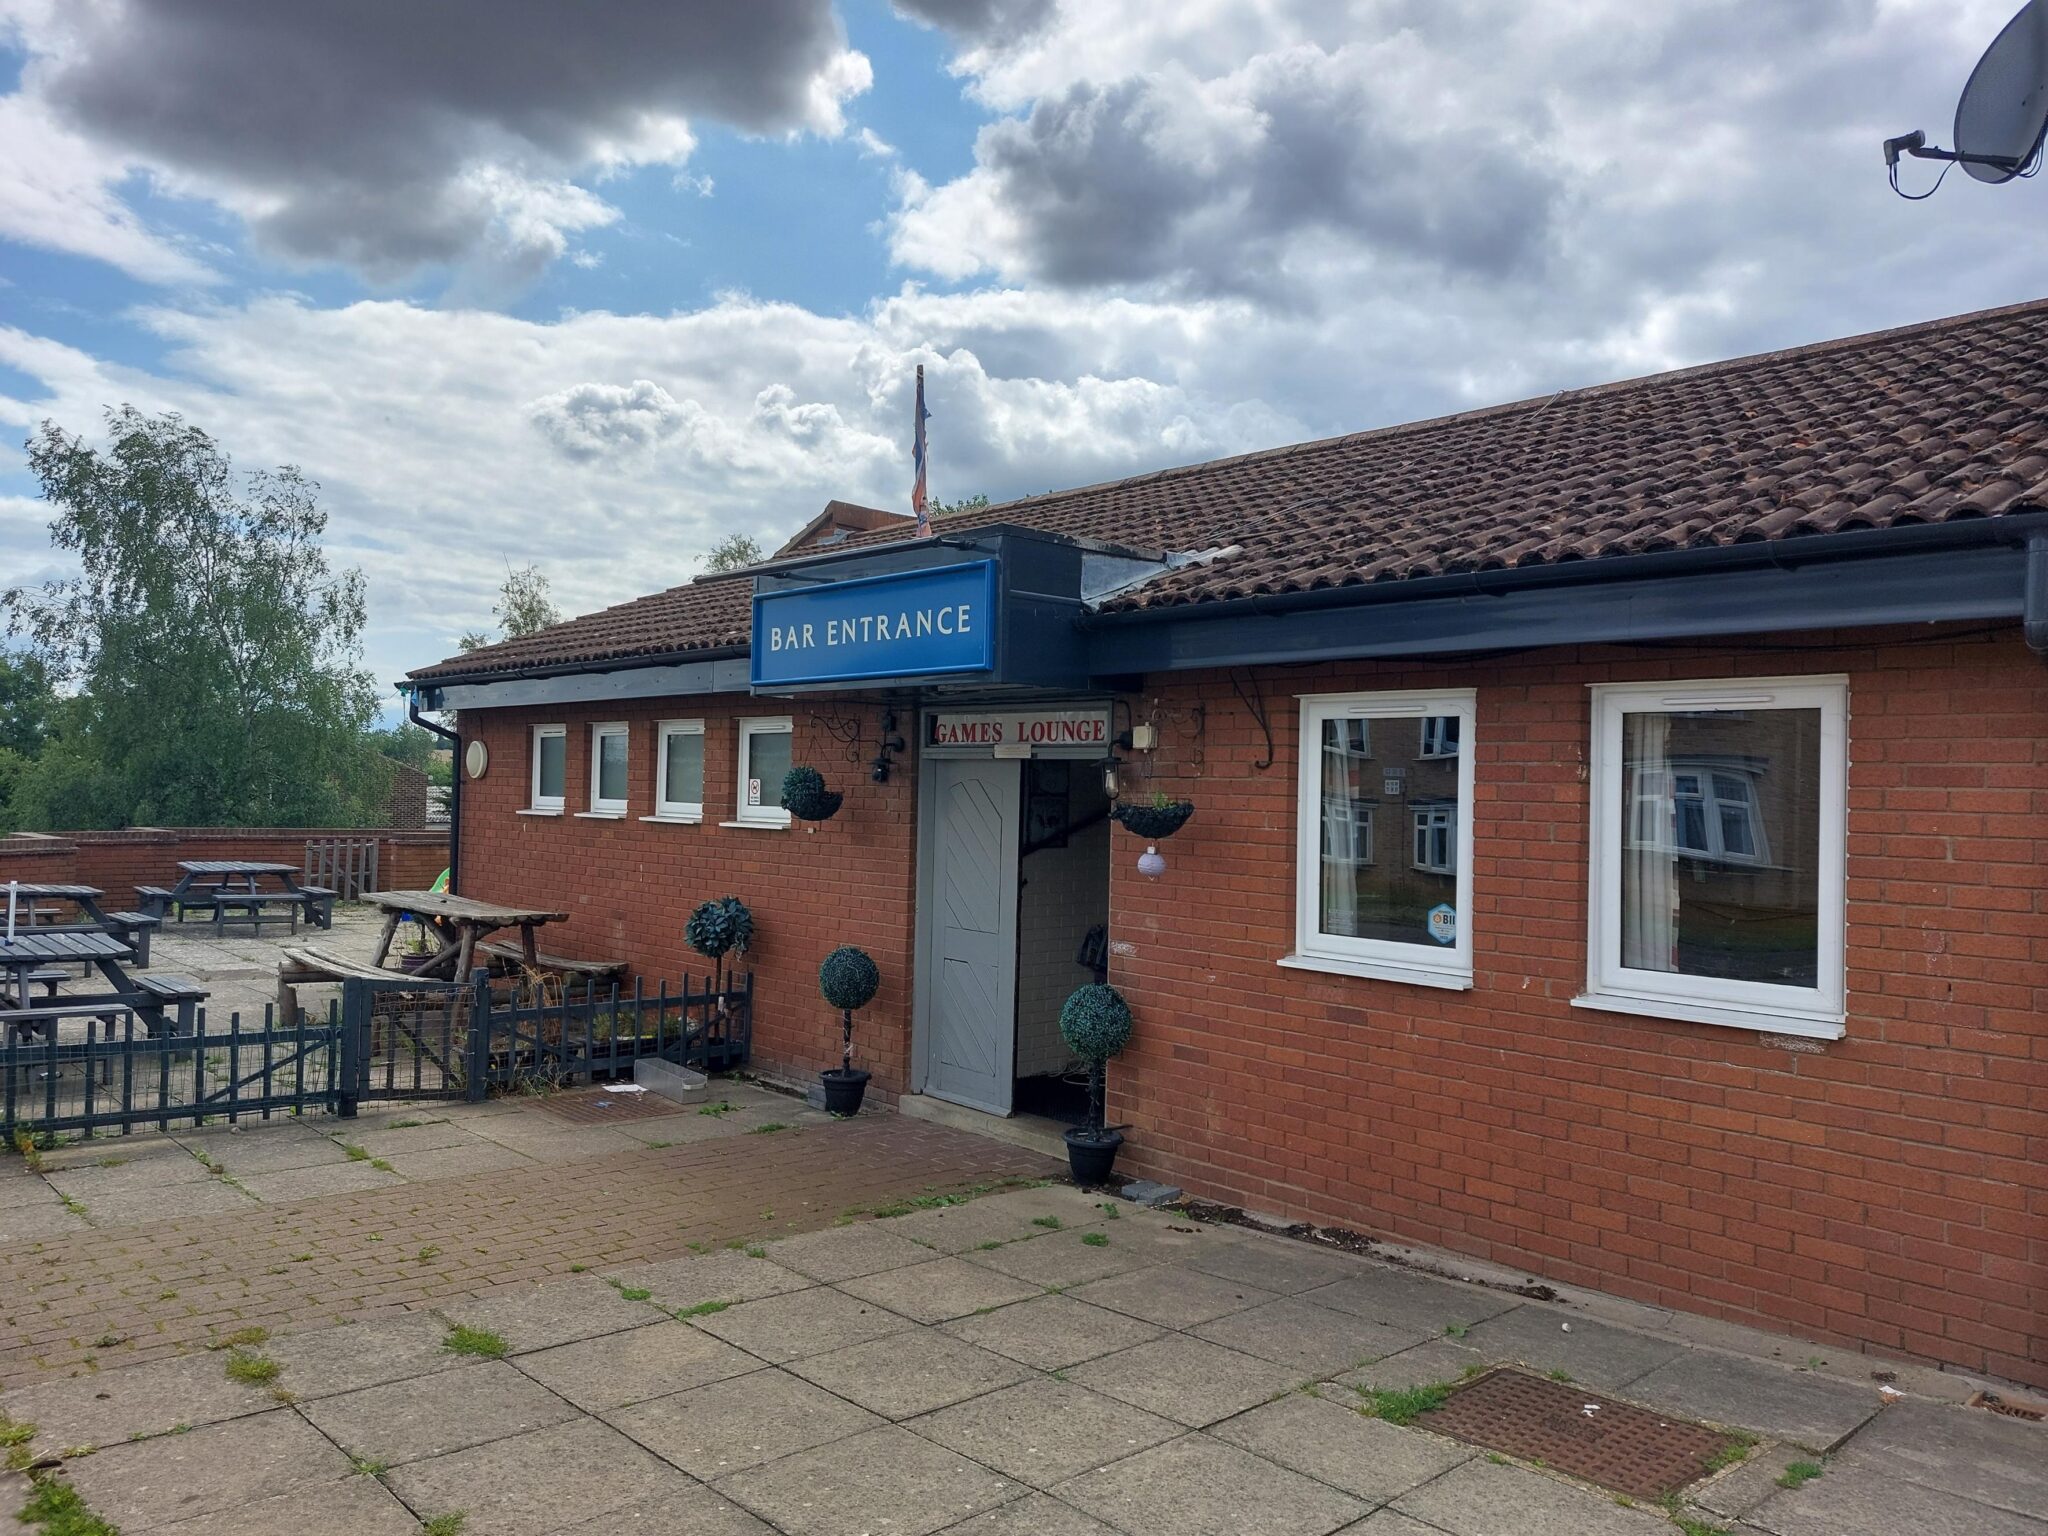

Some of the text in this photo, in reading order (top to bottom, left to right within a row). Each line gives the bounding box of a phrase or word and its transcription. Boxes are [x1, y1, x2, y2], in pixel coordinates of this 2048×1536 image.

[770, 604, 972, 652] BAR ENTRANCE
[935, 719, 1106, 744] GAMES LOUNGE
